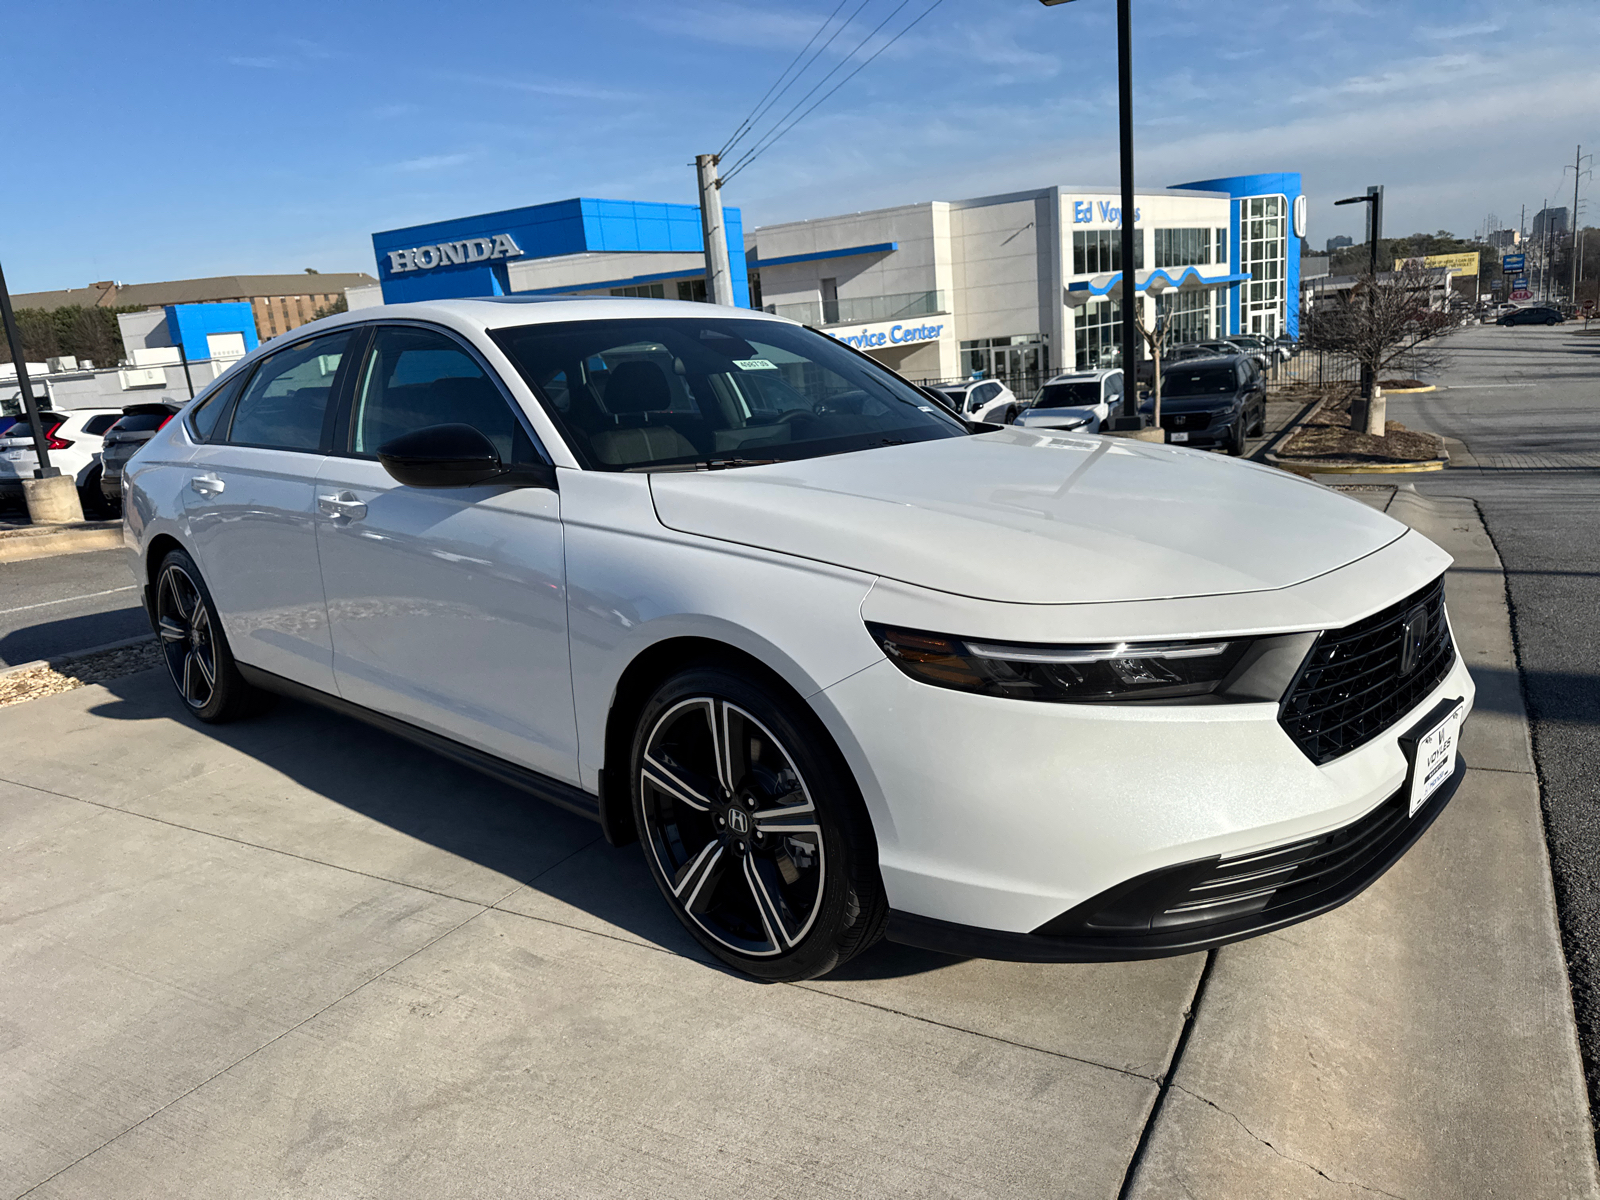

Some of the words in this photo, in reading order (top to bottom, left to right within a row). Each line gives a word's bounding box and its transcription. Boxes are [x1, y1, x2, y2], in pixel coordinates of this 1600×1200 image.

[1074, 200, 1093, 223] Ed
[387, 233, 521, 274] HONDA
[890, 324, 944, 344] Center
[1427, 736, 1452, 767] VOYLES
